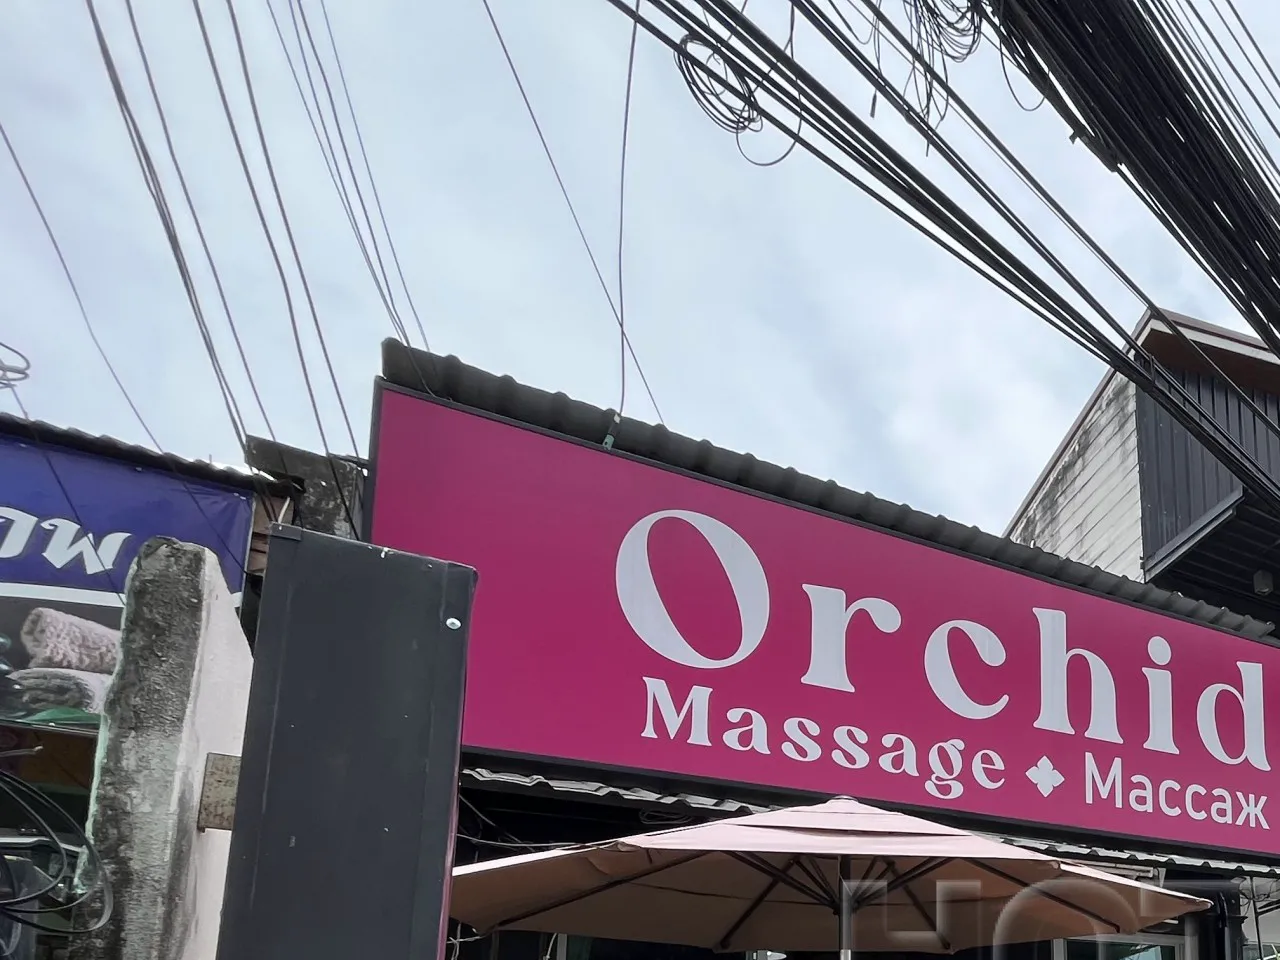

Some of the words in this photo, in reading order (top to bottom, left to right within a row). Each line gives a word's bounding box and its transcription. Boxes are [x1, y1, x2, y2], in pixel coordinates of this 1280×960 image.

[614, 508, 1272, 771] Orchid
[641, 676, 1006, 800] Massage
[1085, 751, 1271, 831] Массаж
